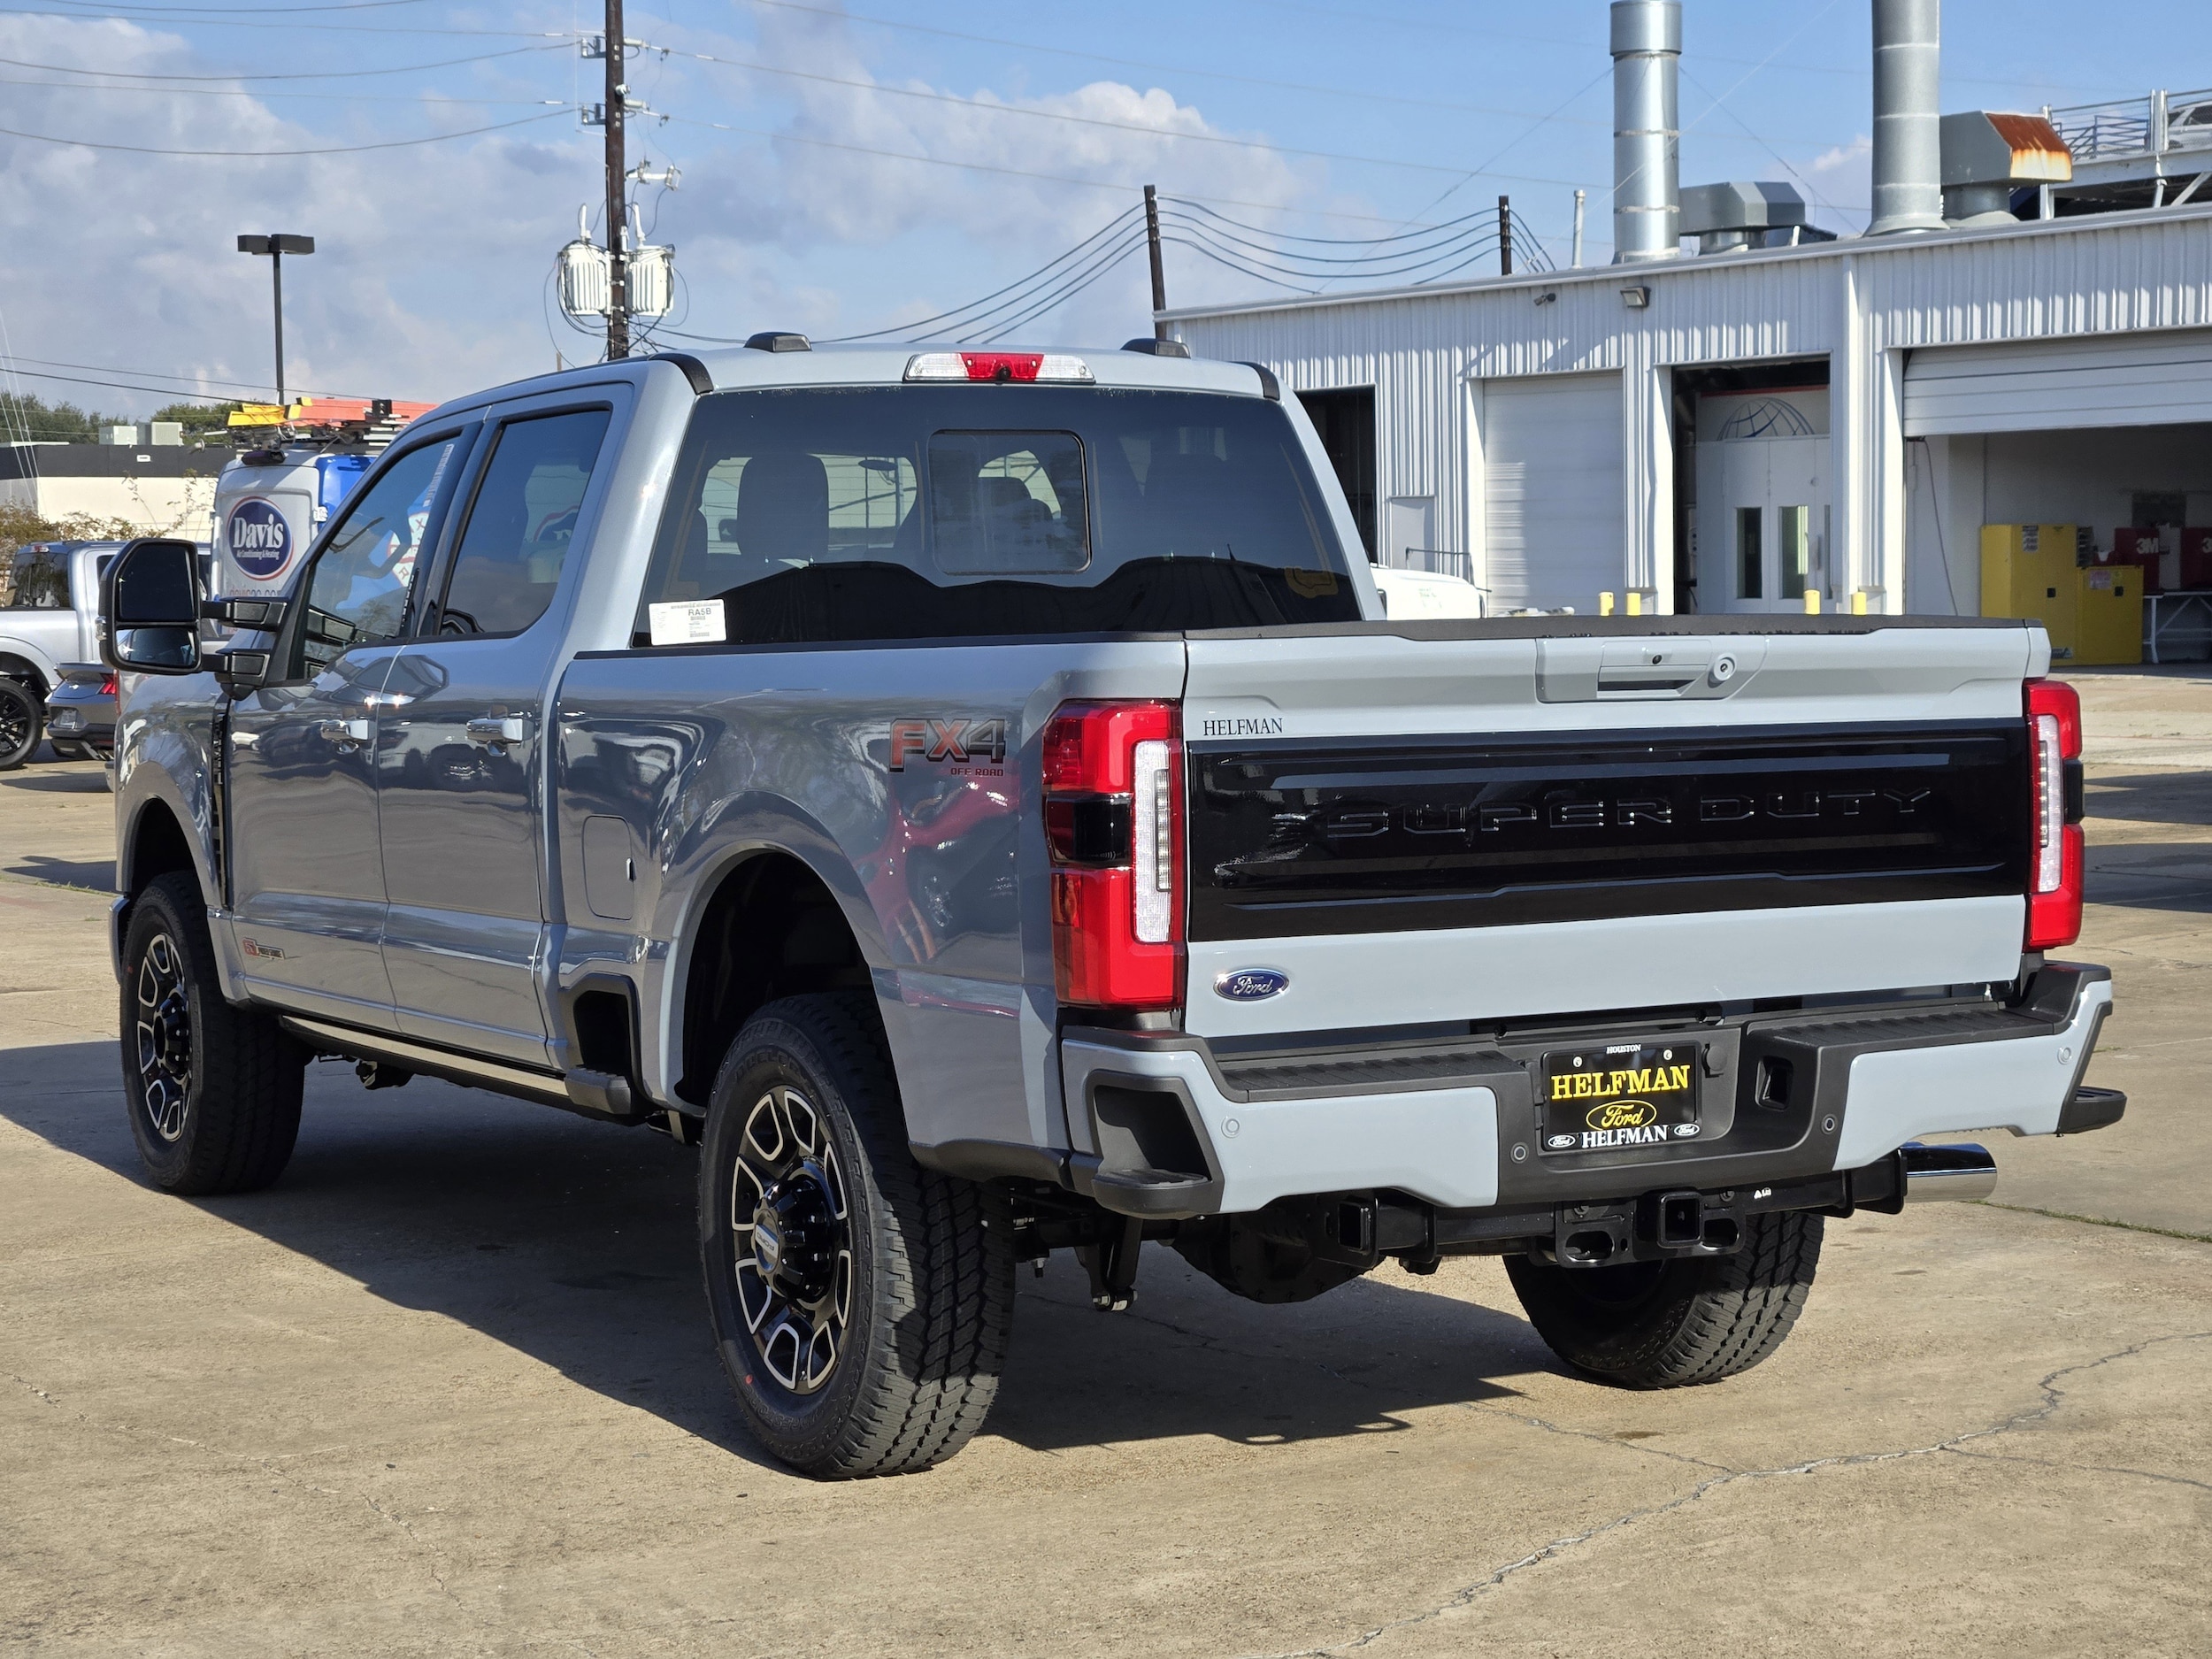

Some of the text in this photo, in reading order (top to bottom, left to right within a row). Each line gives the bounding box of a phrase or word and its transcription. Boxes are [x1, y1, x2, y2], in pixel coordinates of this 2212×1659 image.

[233, 513, 284, 549] Davis
[2136, 537, 2159, 554] 3M
[2202, 537, 2212, 554] 3
[1203, 718, 1283, 736] HELFMAN
[889, 718, 1006, 772] FX4
[950, 767, 1004, 777] OFF ROAD
[1327, 787, 1932, 838] SUPER DUTY
[1233, 975, 1274, 995] Ford
[1606, 1044, 1641, 1054] HOUSTON
[1551, 1064, 1691, 1100] HELFMAN
[1601, 1103, 1645, 1128] Ford
[1581, 1125, 1670, 1148] HELFMAN
